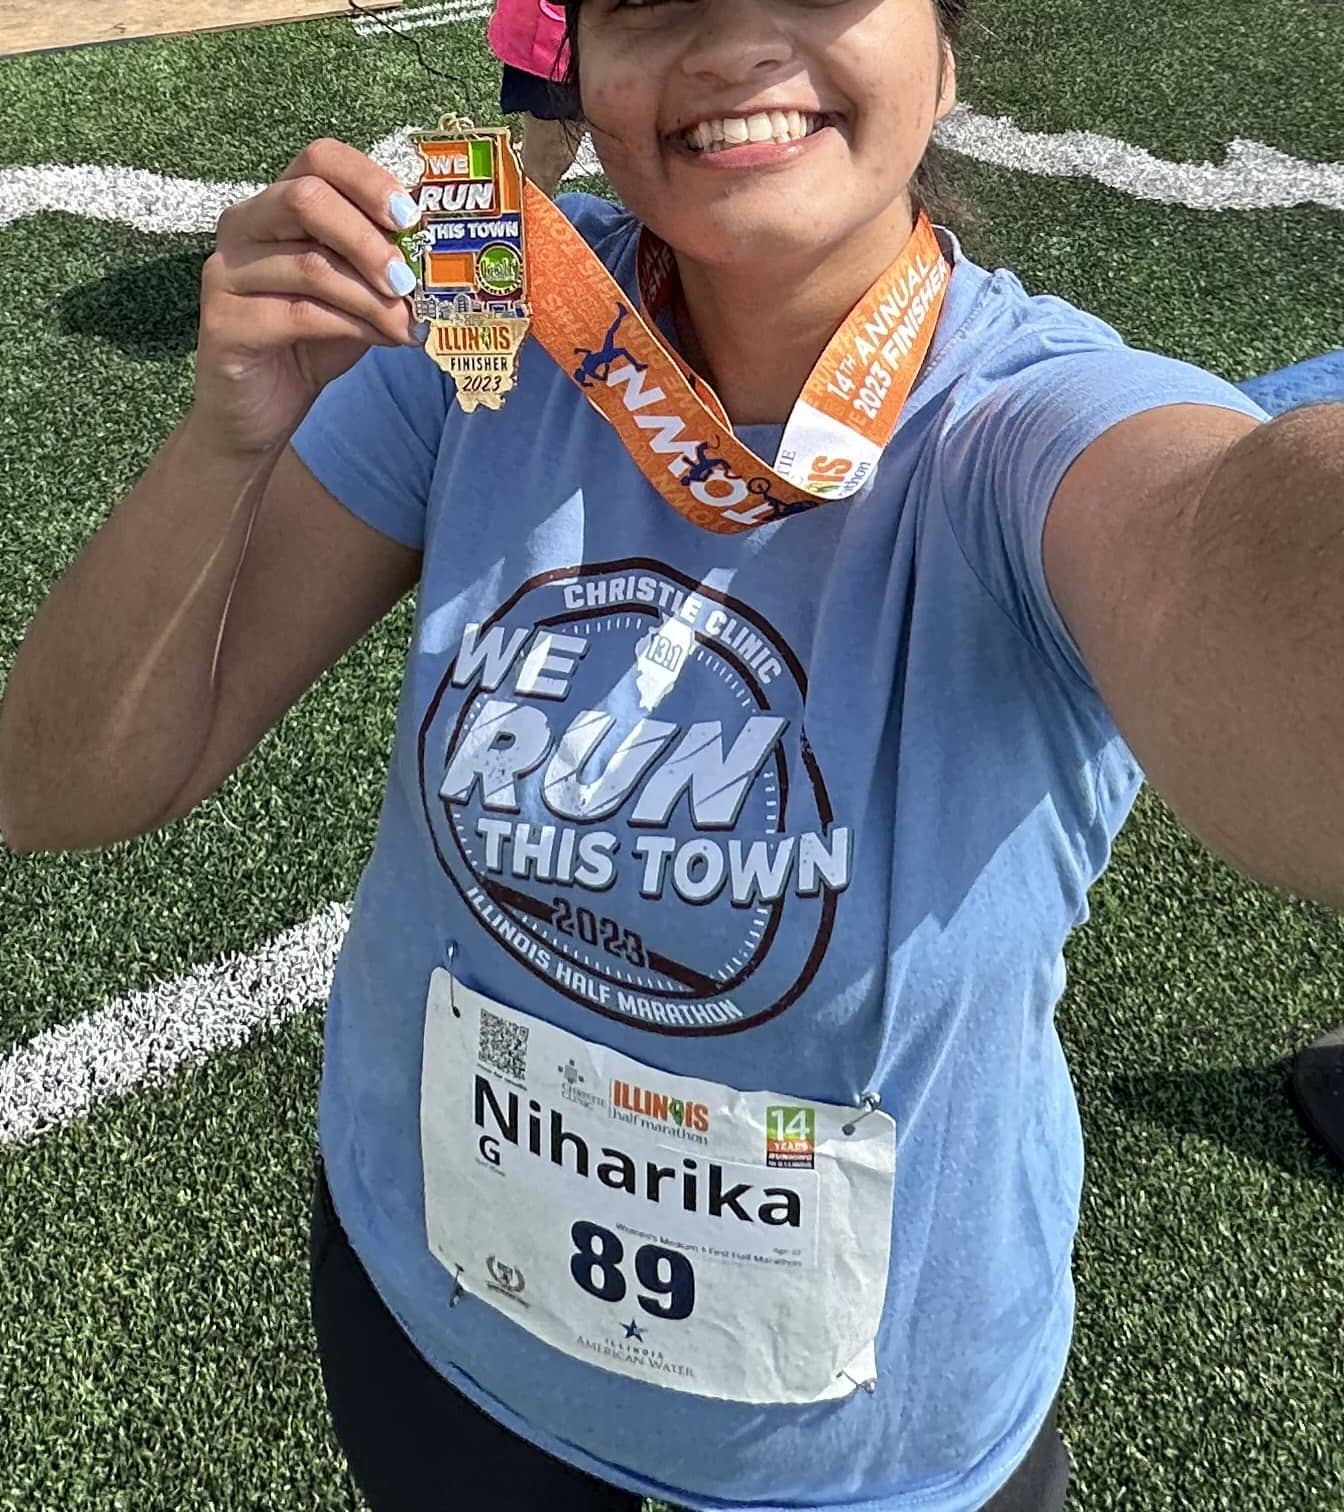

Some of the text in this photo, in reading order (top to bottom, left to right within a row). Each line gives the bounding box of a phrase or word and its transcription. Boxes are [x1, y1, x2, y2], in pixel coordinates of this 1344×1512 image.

[418, 182, 494, 211] RUN
[427, 154, 470, 175] WE
[426, 220, 519, 240] THIS TOWN
[853, 254, 950, 420] 2023 FINISHER
[855, 253, 931, 364] ANNUAL
[449, 355, 508, 372] FINISHER
[461, 376, 503, 392] 2023
[451, 622, 589, 701] WE
[562, 576, 783, 684] CHRISTIE CLINIC
[439, 699, 790, 832] RUN
[476, 816, 854, 907] THIS TOWN
[466, 886, 744, 1026] ILLINOIS HALF MARATHON
[552, 896, 648, 967] 2023
[474, 1073, 802, 1228] Niharika
[478, 1135, 501, 1166] G
[612, 1109, 709, 1146] half marathon
[770, 1108, 811, 1141] 14
[569, 1219, 696, 1321] 89
[576, 1335, 696, 1378] AMERICAN WATER
